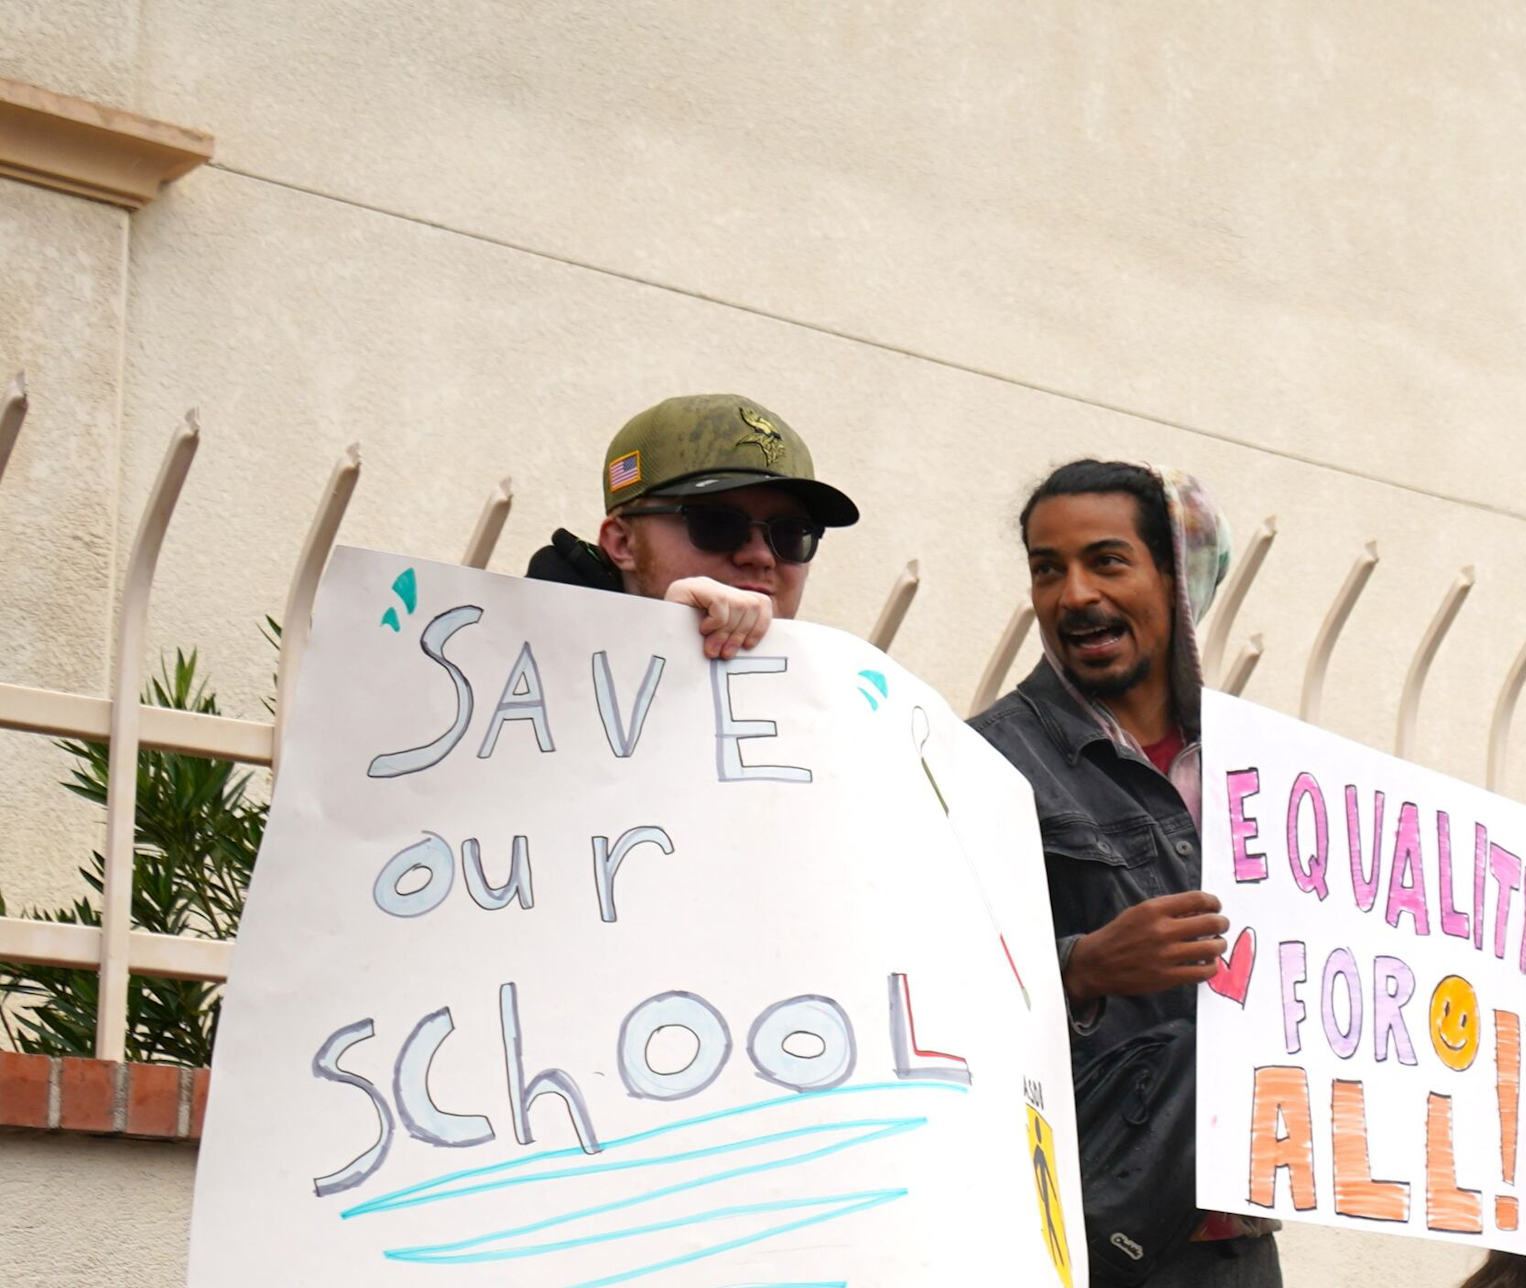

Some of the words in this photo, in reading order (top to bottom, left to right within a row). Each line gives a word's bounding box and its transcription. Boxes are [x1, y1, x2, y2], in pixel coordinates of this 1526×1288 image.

[367, 604, 813, 783] SAVE
[373, 825, 674, 923] our
[1278, 940, 1418, 1067] FOR
